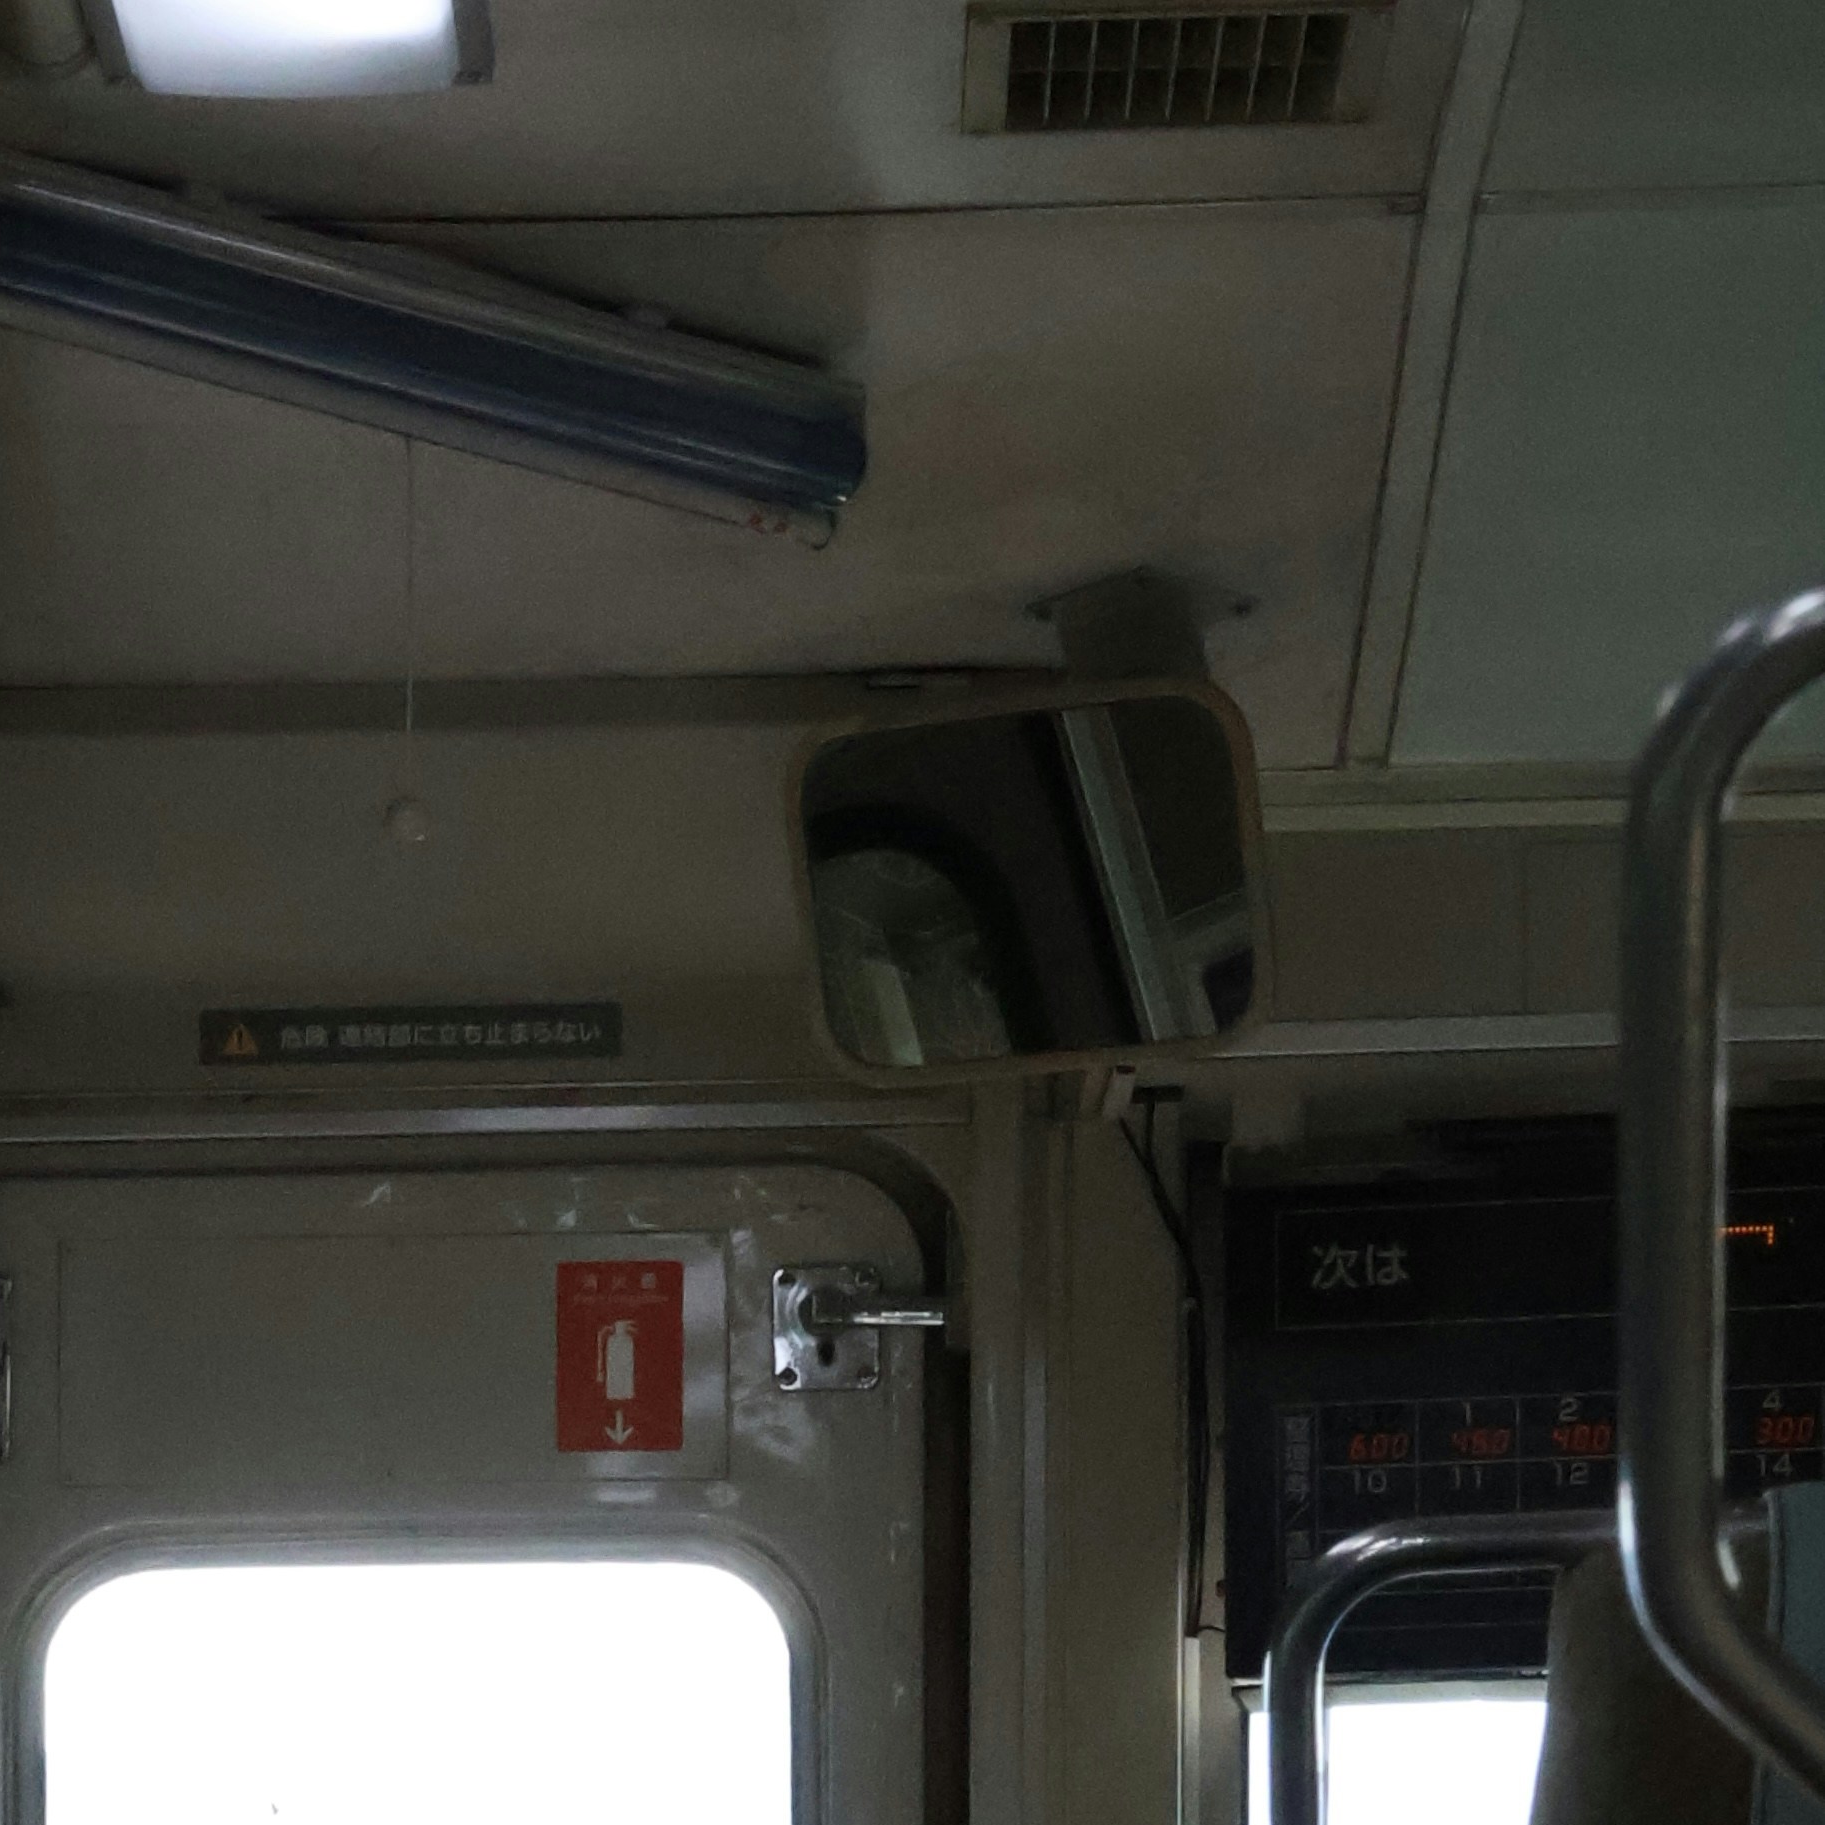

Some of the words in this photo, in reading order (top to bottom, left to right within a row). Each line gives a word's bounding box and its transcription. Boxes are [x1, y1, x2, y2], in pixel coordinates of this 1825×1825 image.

[278, 1022, 330, 1050] 危険
[1309, 1242, 1410, 1290] 次は
[1462, 1401, 1472, 1426] 1
[1558, 1397, 1580, 1421] 2
[1762, 1389, 1784, 1412] 4
[1347, 1432, 1410, 1462] 600
[1754, 1413, 1815, 1448] 300
[1352, 1469, 1388, 1494] 10
[1452, 1466, 1483, 1490] 11
[1551, 1462, 1590, 1487] 12
[1755, 1452, 1795, 1478] 14
